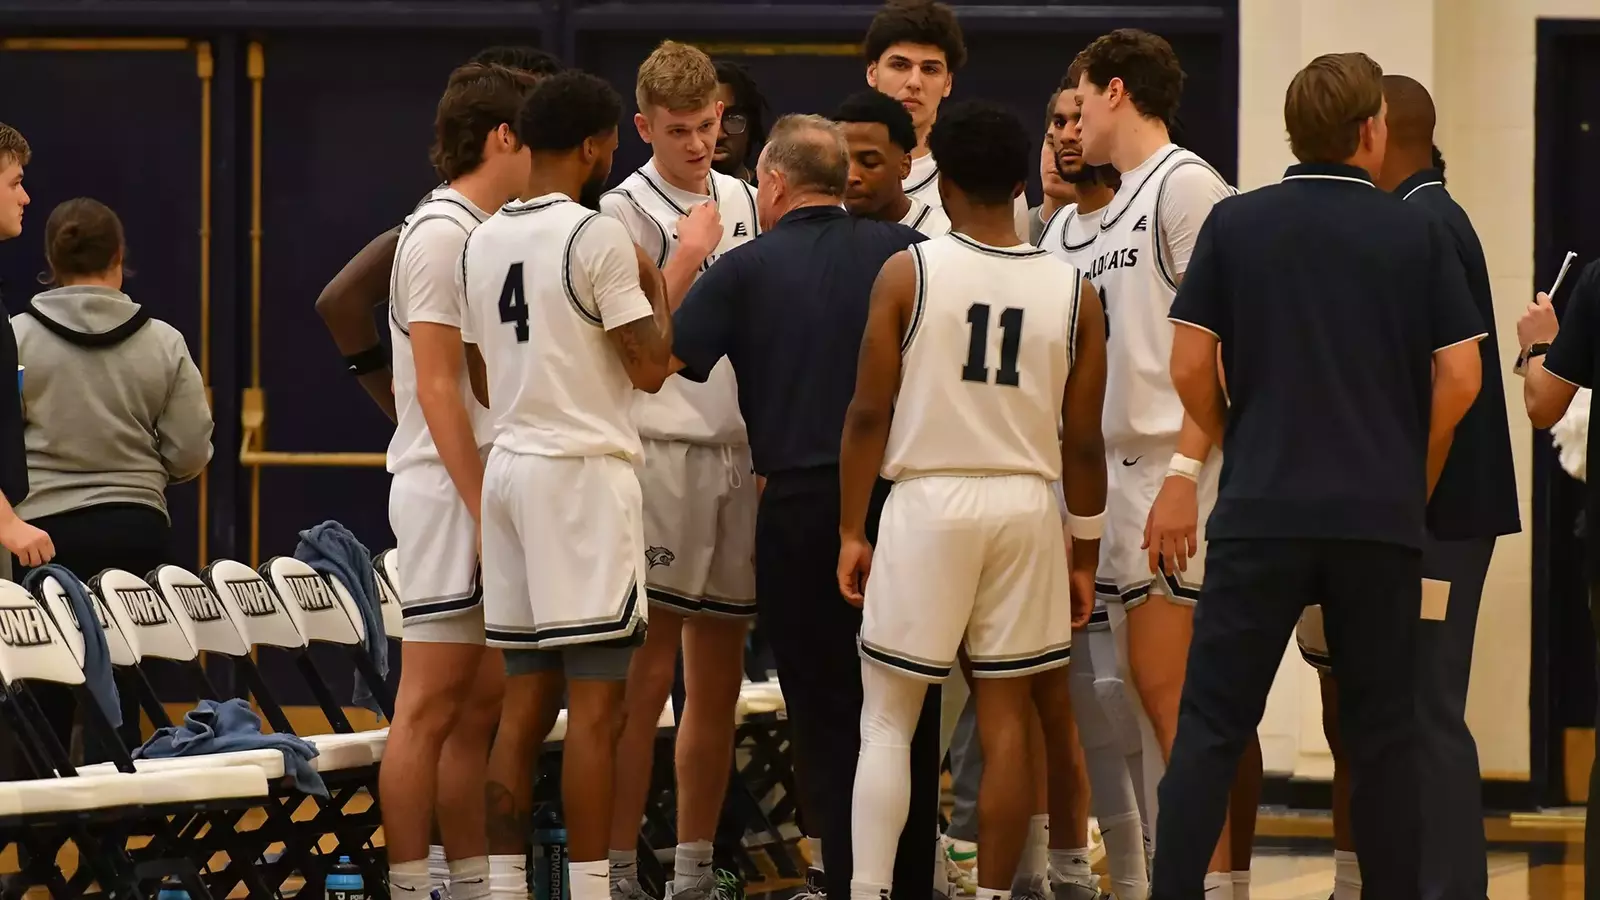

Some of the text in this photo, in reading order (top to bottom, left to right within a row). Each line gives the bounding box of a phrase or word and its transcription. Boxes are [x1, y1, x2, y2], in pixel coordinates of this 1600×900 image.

[498, 261, 530, 344] 4
[960, 302, 1024, 388] 11
[114, 588, 167, 626] UNH
[171, 584, 222, 622] UNH
[225, 578, 277, 616] UNH
[282, 574, 333, 612] UNH
[0, 606, 52, 646] UNH
